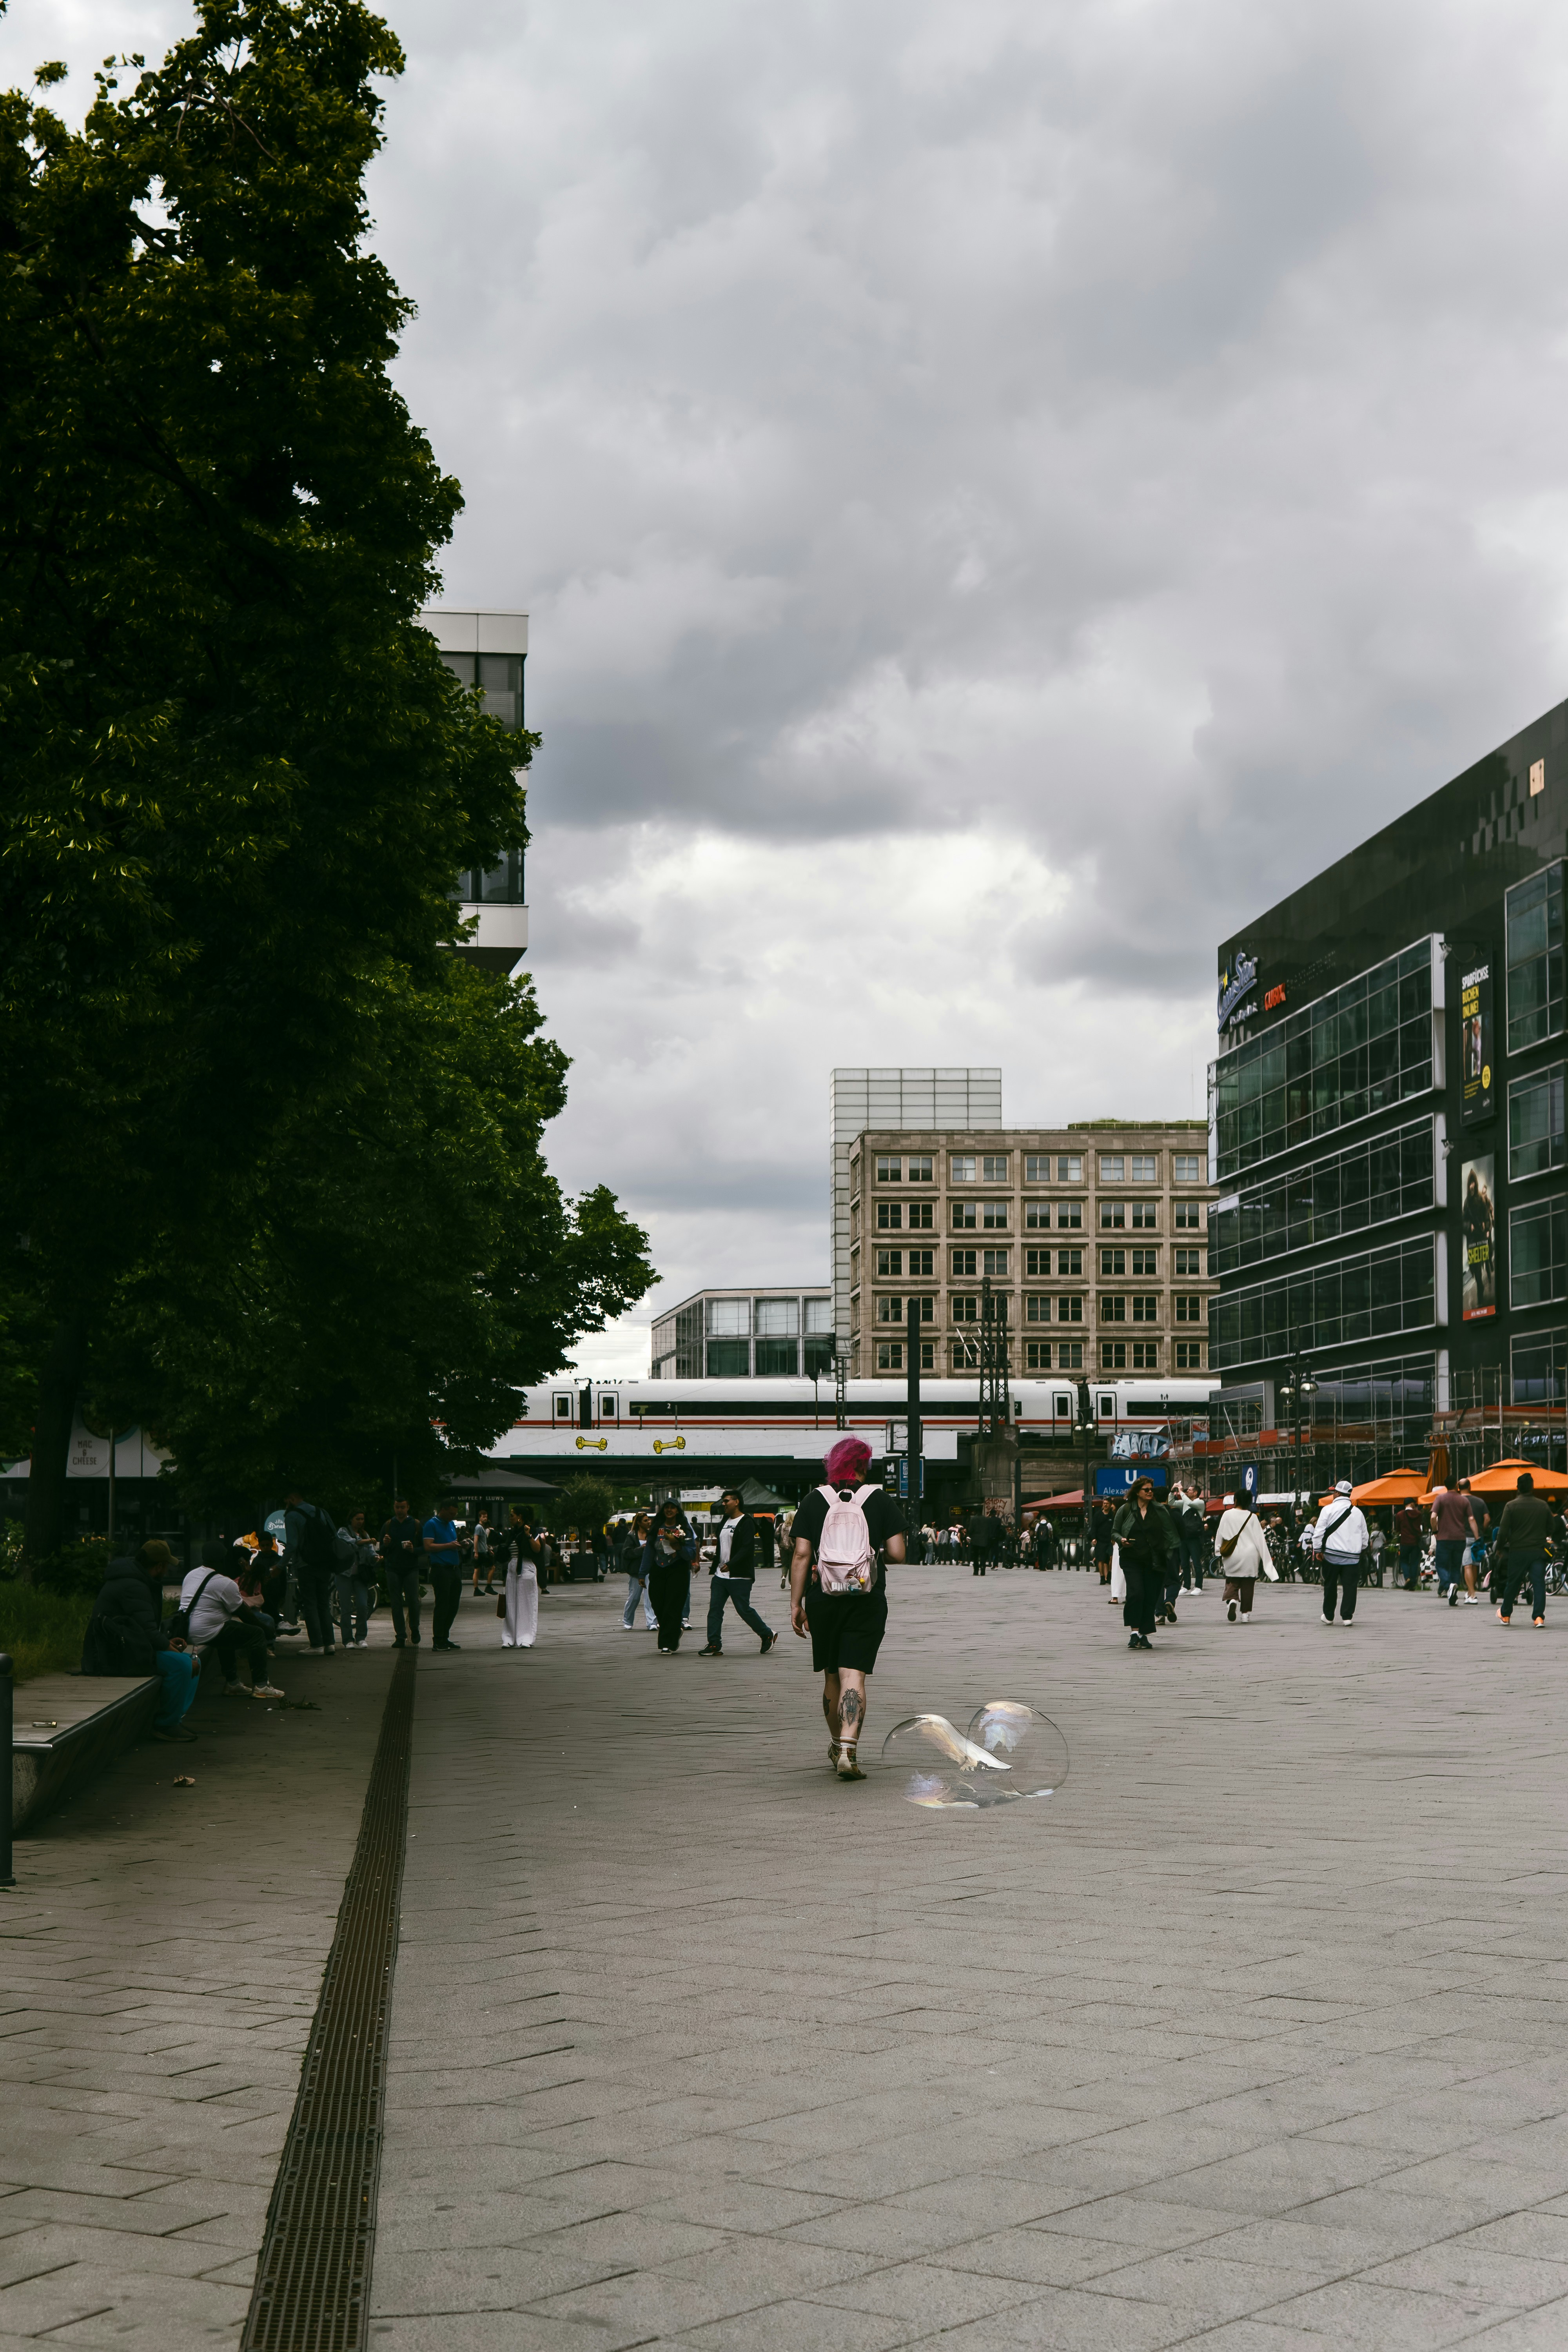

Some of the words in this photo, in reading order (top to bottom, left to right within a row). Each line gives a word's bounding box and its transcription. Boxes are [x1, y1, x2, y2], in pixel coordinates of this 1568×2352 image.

[1462, 965, 1489, 990] SPARFÜCHSE
[1265, 983, 1286, 1011] CUBIX
[1463, 985, 1479, 1004] BUCHEN
[1468, 1244, 1489, 1265] SHELTER
[78, 1440, 92, 1448] MAC
[1125, 1470, 1137, 1485] U
